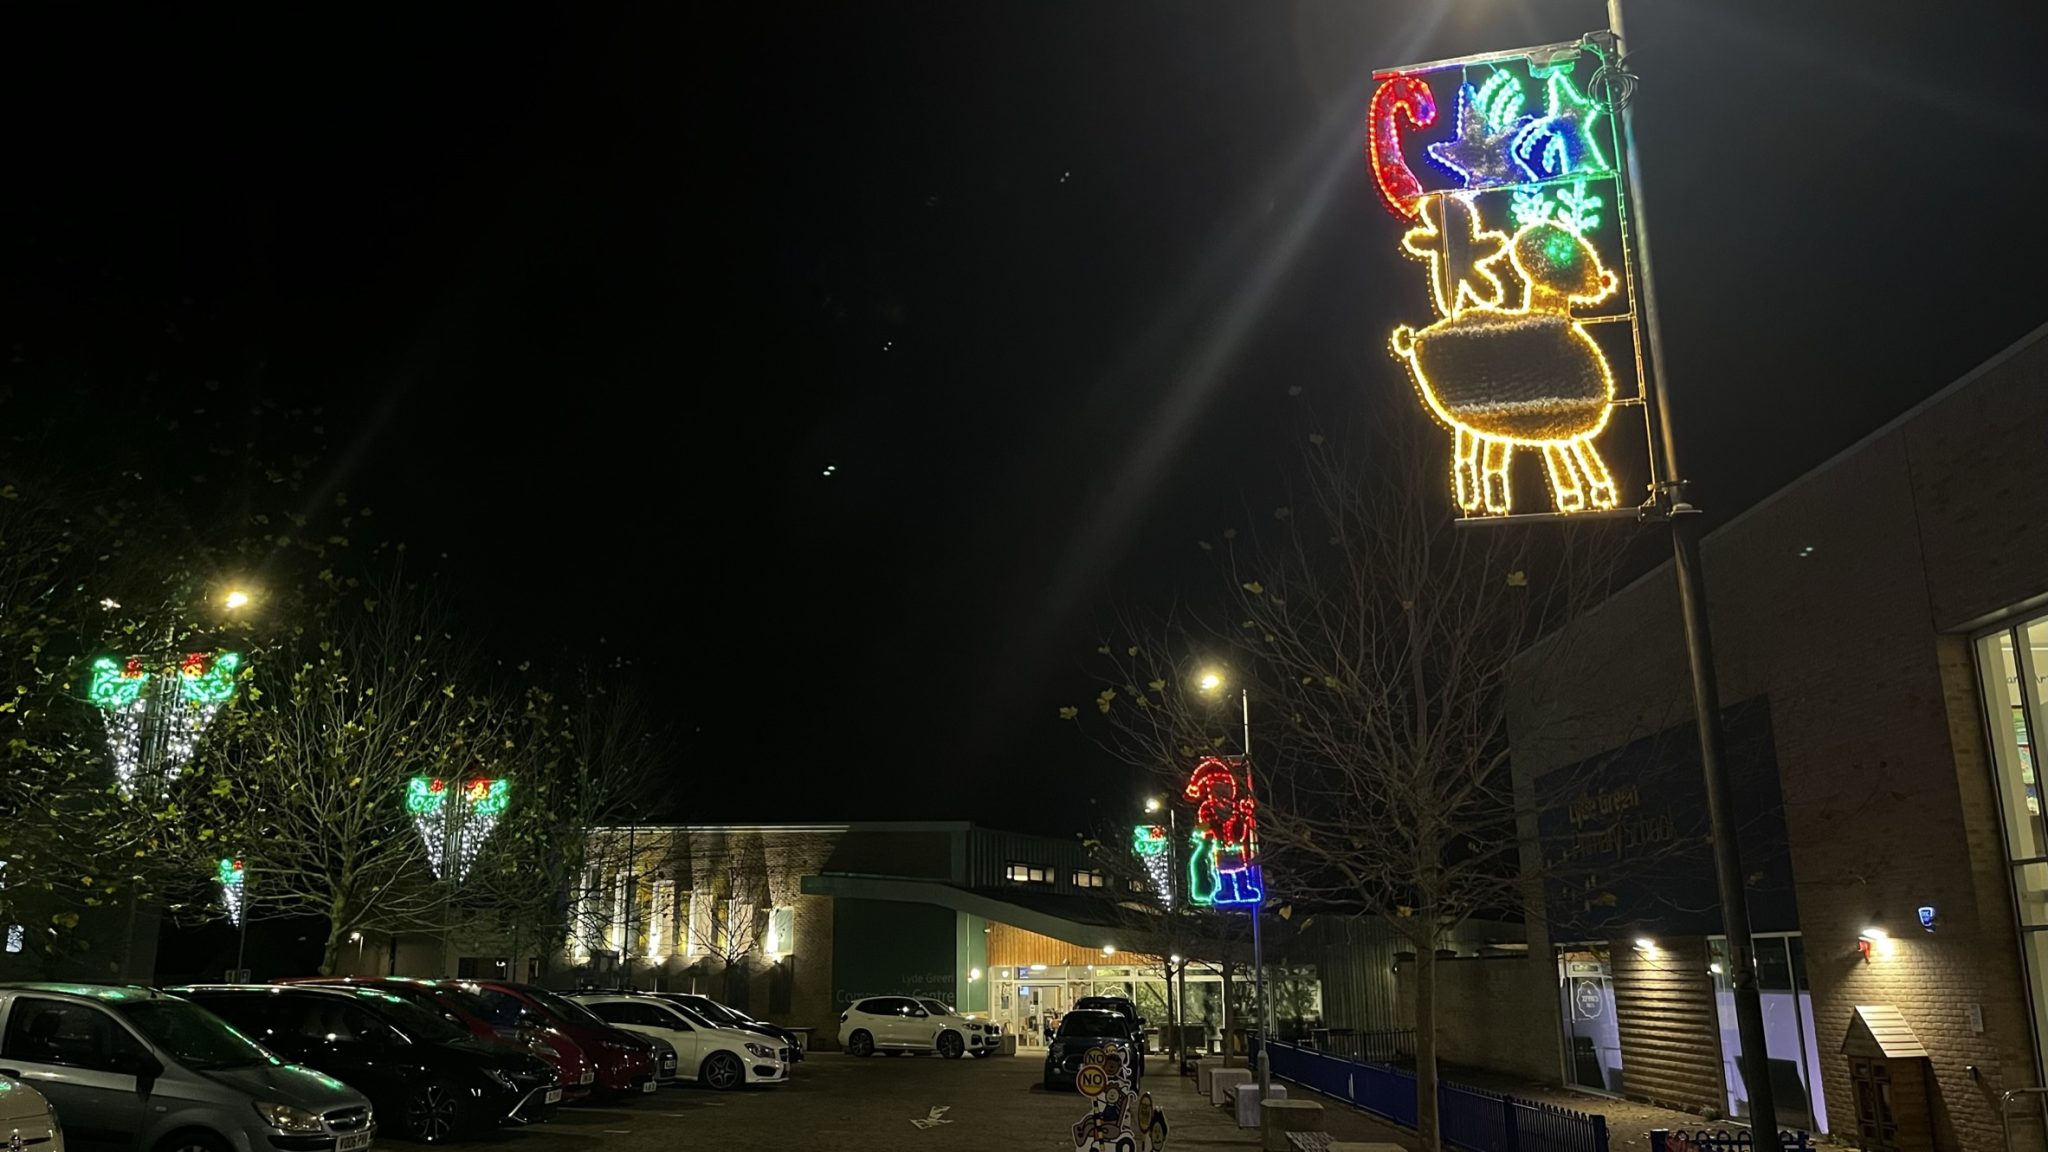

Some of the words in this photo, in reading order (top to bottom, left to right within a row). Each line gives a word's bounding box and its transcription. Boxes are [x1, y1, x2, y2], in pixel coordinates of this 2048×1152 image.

[902, 974, 923, 986] Lyde
[925, 973, 954, 984] Green
[1088, 1054, 1105, 1063] NO
[1083, 1073, 1103, 1085] NO
